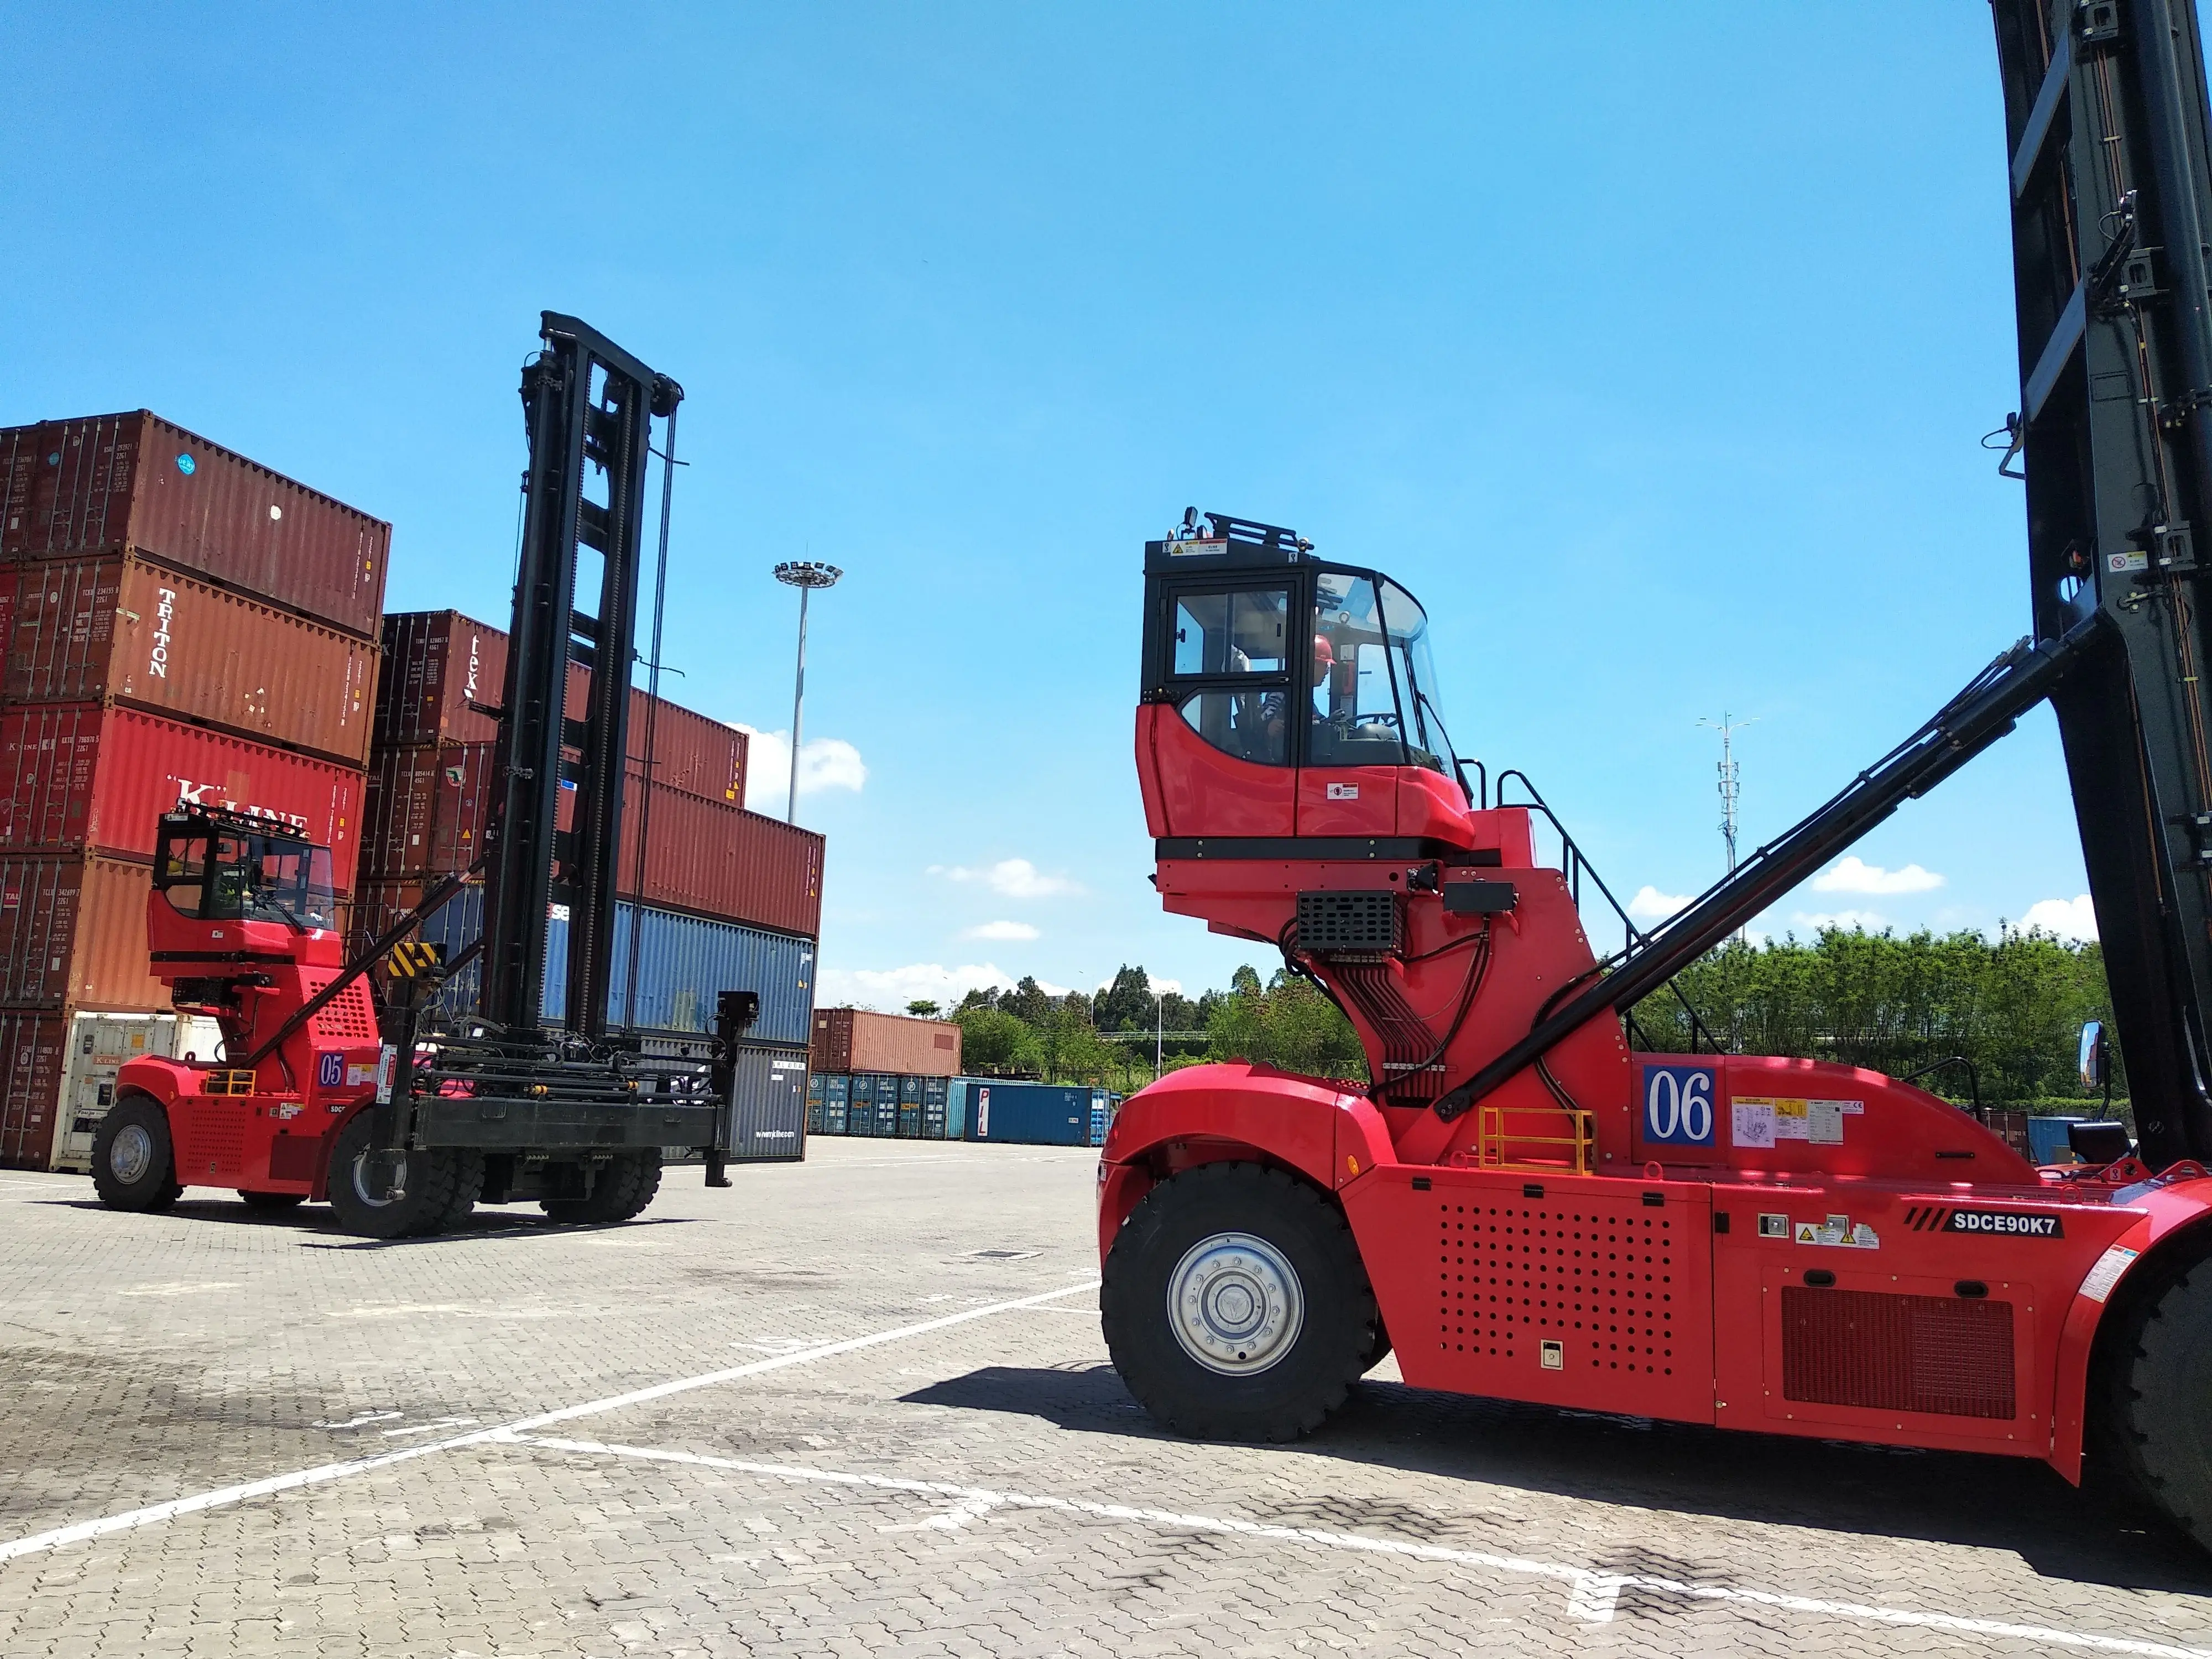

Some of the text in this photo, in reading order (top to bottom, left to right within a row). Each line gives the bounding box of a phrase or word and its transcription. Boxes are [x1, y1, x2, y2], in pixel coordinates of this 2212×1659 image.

[149, 587, 176, 678] TRITON
[58, 888, 76, 896] 342699
[320, 1055, 343, 1084] 05
[978, 1090, 989, 1134] PIL
[1649, 1070, 1712, 1140] 06
[1954, 1213, 2056, 1234] SDCE90K7
